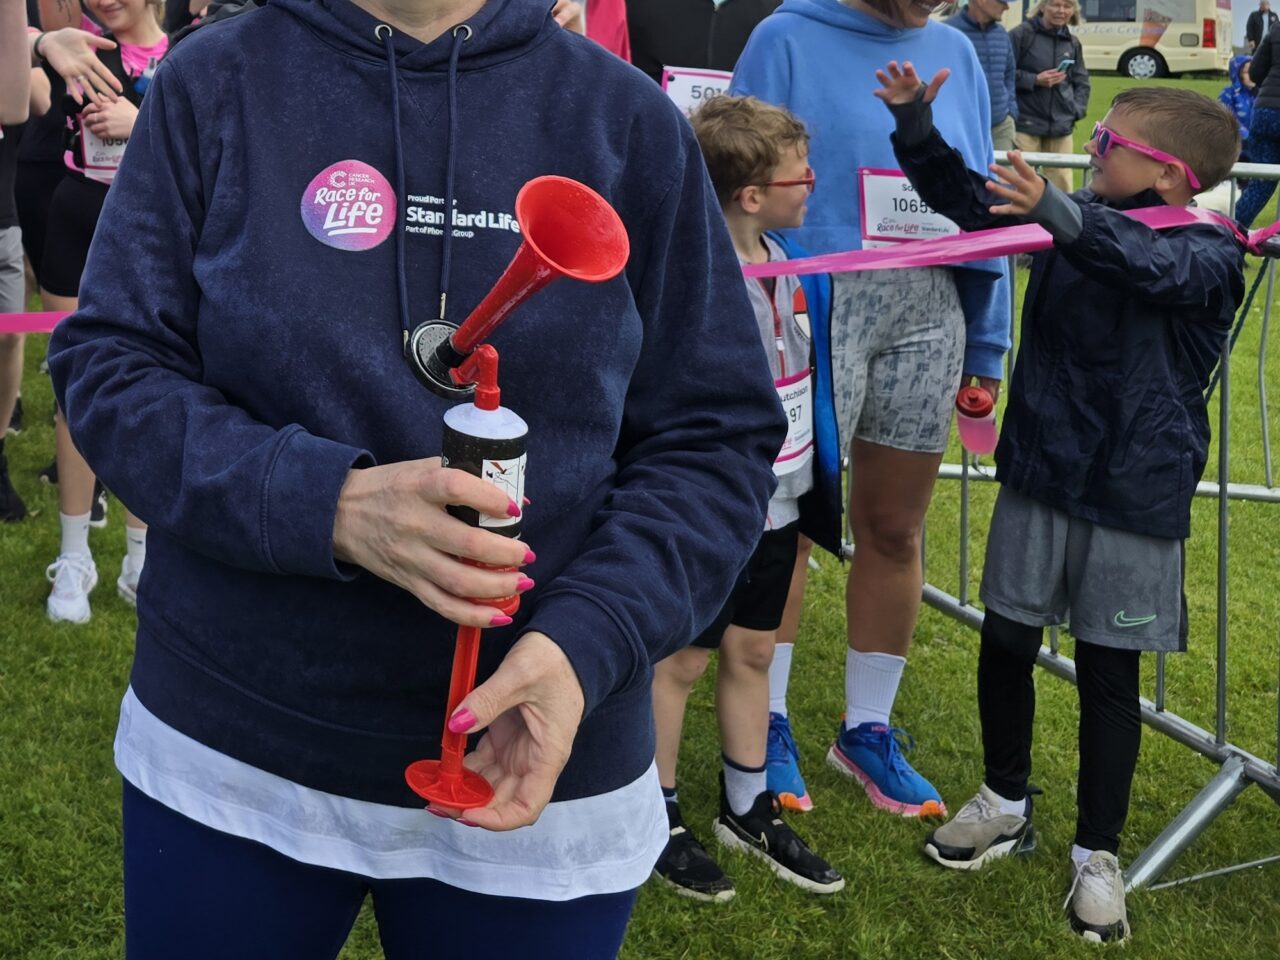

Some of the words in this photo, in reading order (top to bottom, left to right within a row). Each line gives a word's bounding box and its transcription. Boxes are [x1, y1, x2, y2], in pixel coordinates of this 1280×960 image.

[902, 183, 913, 192] Sa
[314, 187, 356, 205] Race
[358, 187, 381, 202] for
[408, 195, 429, 203] Proud
[429, 196, 457, 206] Partr
[323, 201, 383, 230] Life
[420, 226, 427, 234] of
[488, 213, 520, 233] Life
[876, 223, 894, 232] Race
[780, 385, 808, 402] utchison
